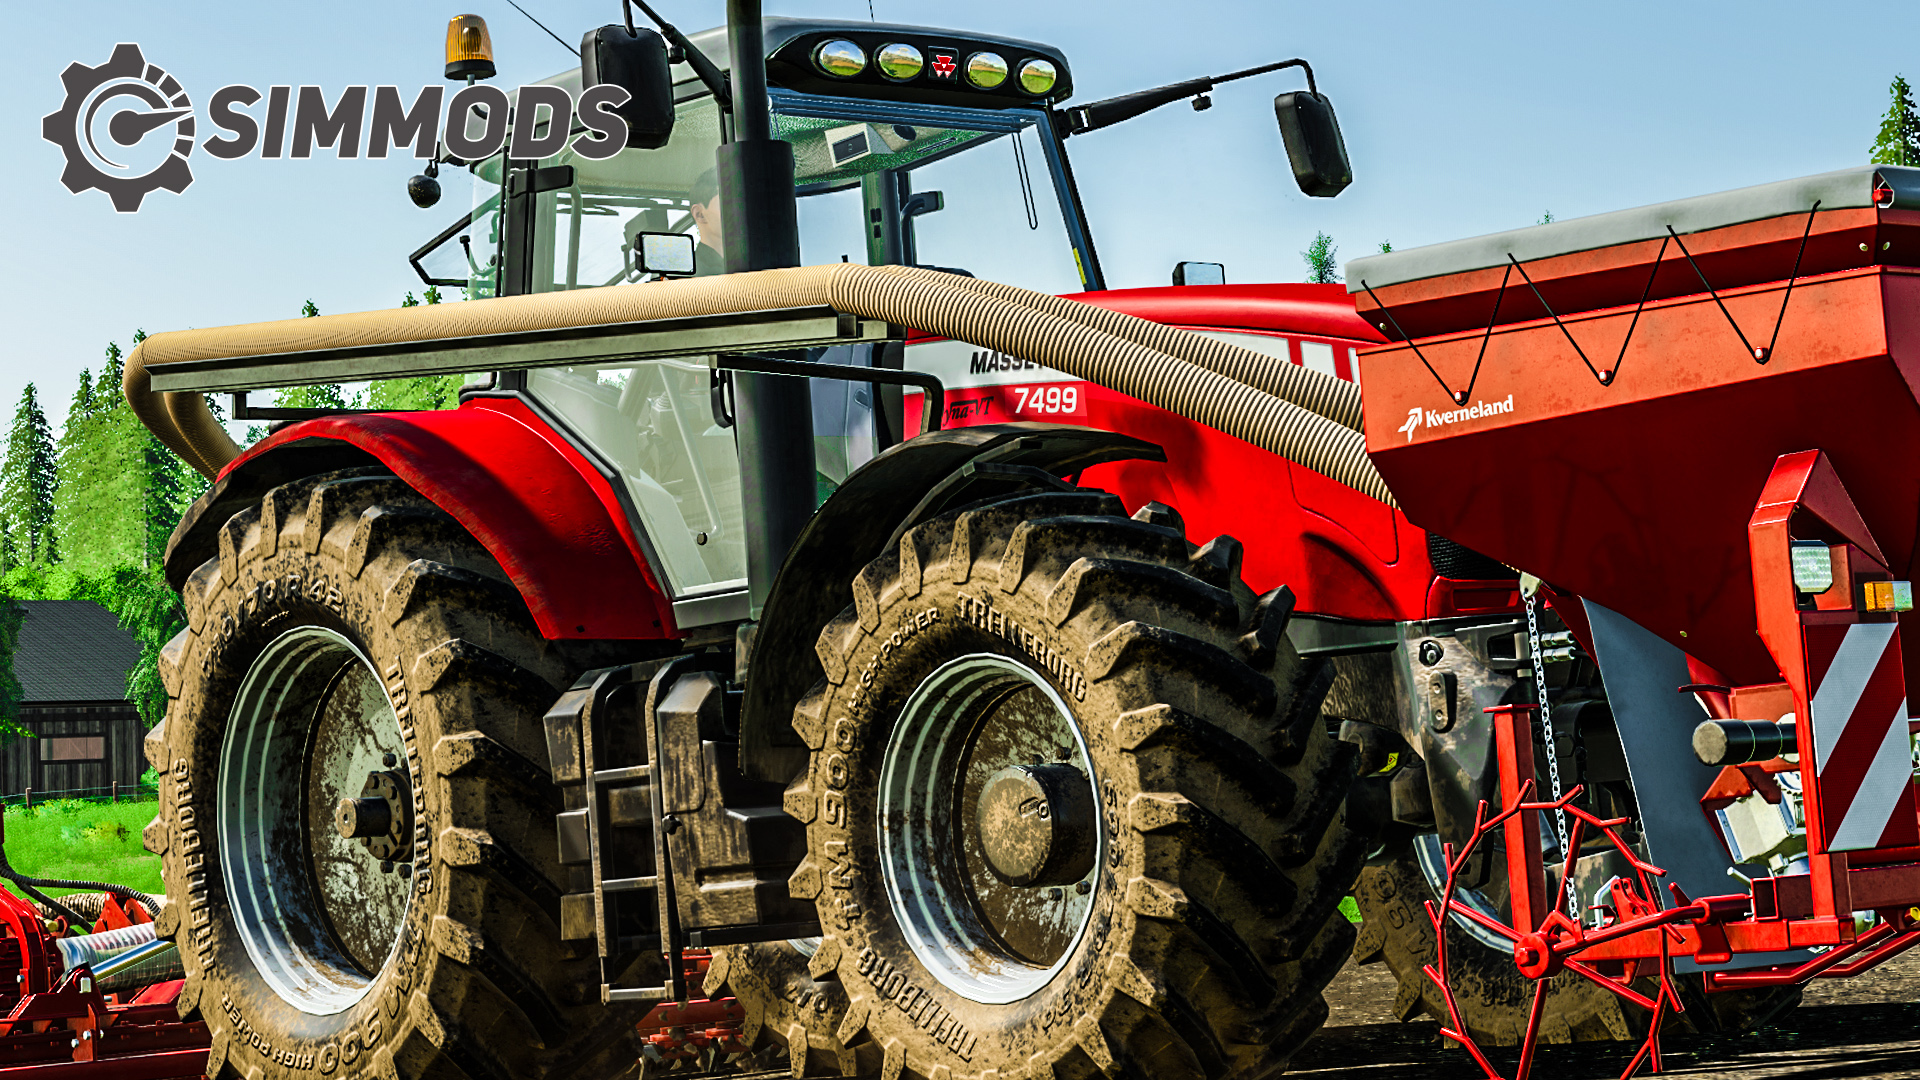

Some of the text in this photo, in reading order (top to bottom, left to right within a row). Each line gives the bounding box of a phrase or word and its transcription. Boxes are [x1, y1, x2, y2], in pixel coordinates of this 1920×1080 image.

[969, 351, 1043, 374] MASS
[942, 396, 994, 427] yna-VT
[1014, 386, 1077, 414] 7499
[1425, 394, 1514, 428] Kverneland
[881, 607, 941, 654] POWER
[957, 591, 1087, 702] TRELLEBORG
[173, 757, 217, 980] TRELLEBORG
[856, 947, 979, 1063] TRELLEBORG
[221, 992, 315, 1070] HIGH POWER
